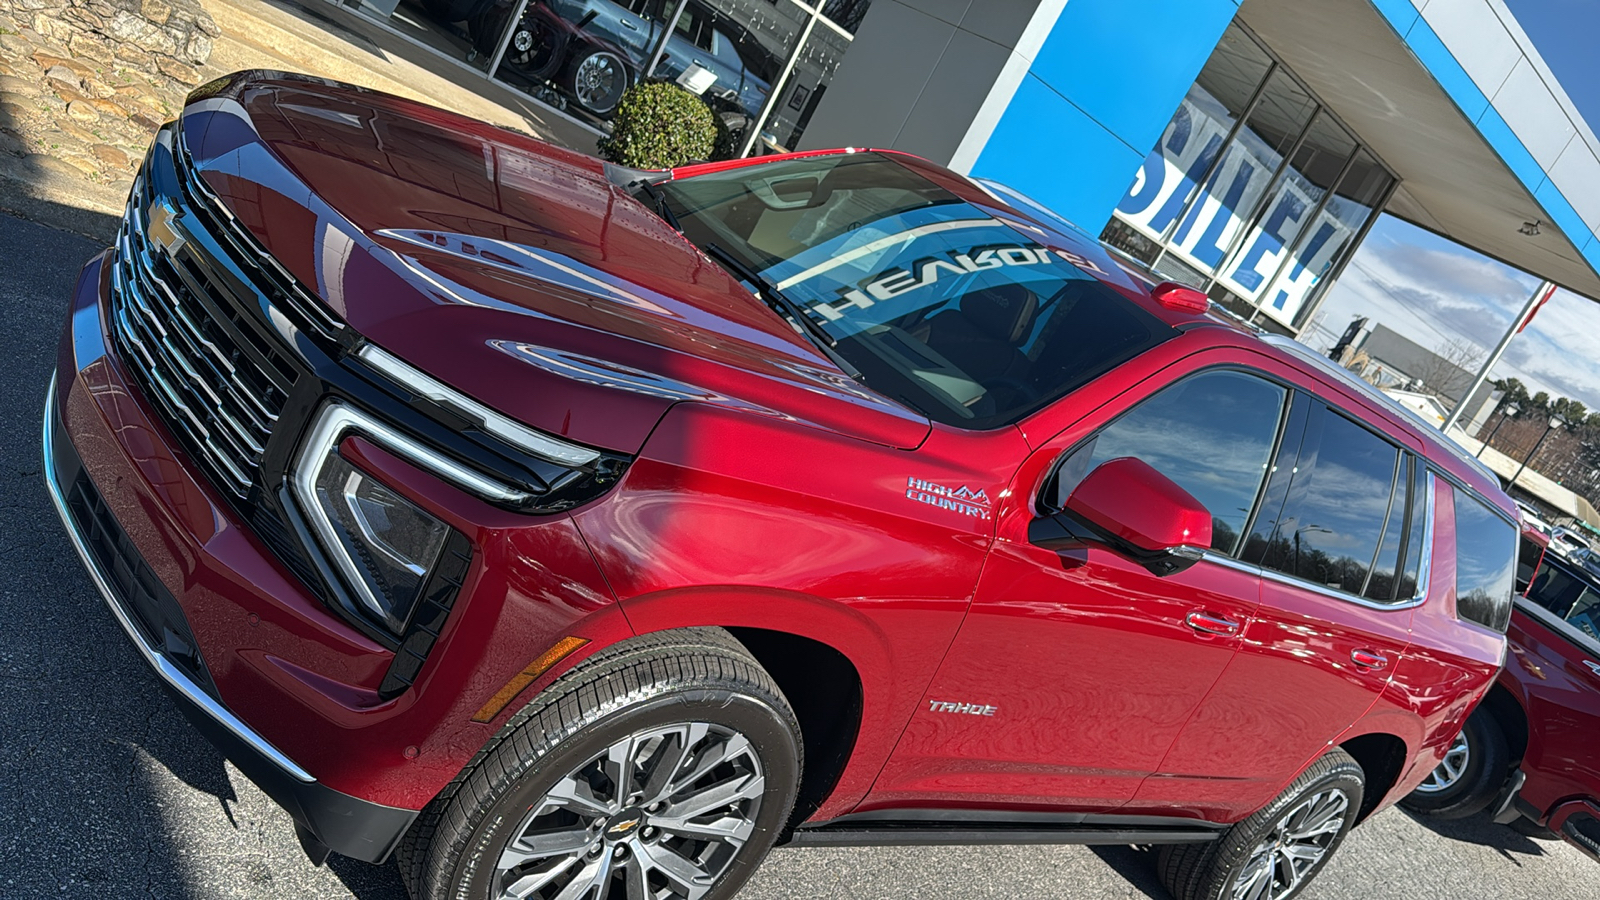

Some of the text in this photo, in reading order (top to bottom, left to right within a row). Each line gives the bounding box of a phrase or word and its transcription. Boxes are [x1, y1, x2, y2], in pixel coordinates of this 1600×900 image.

[908, 476, 954, 498] HIGH
[906, 489, 990, 520] COUNTRY
[929, 699, 998, 717] TAHOE
